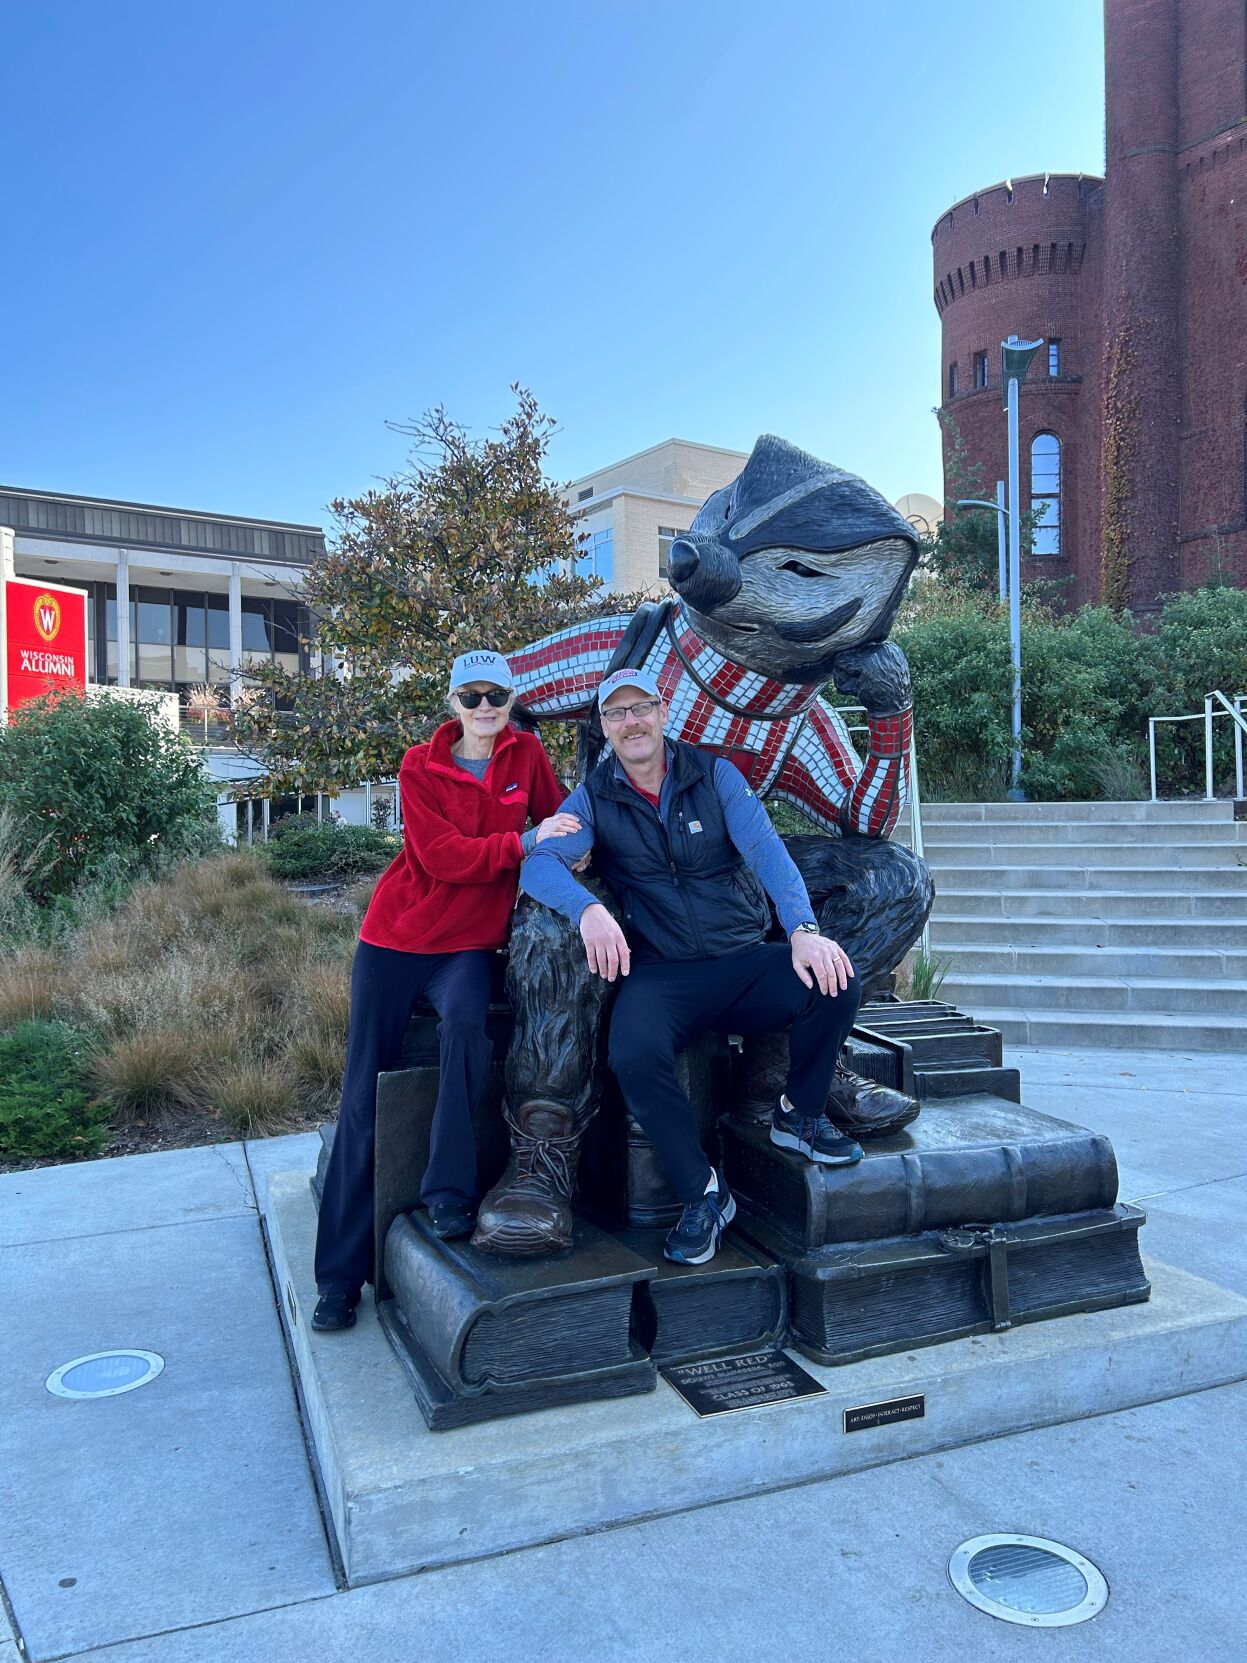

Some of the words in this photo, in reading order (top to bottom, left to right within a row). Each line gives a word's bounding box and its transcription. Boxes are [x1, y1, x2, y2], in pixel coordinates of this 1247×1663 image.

[40, 608, 56, 633] W
[20, 650, 75, 664] WISCONSIN
[21, 659, 75, 677] ALUMNI
[678, 1362, 732, 1376] "WELL
[735, 1353, 773, 1368] RED"
